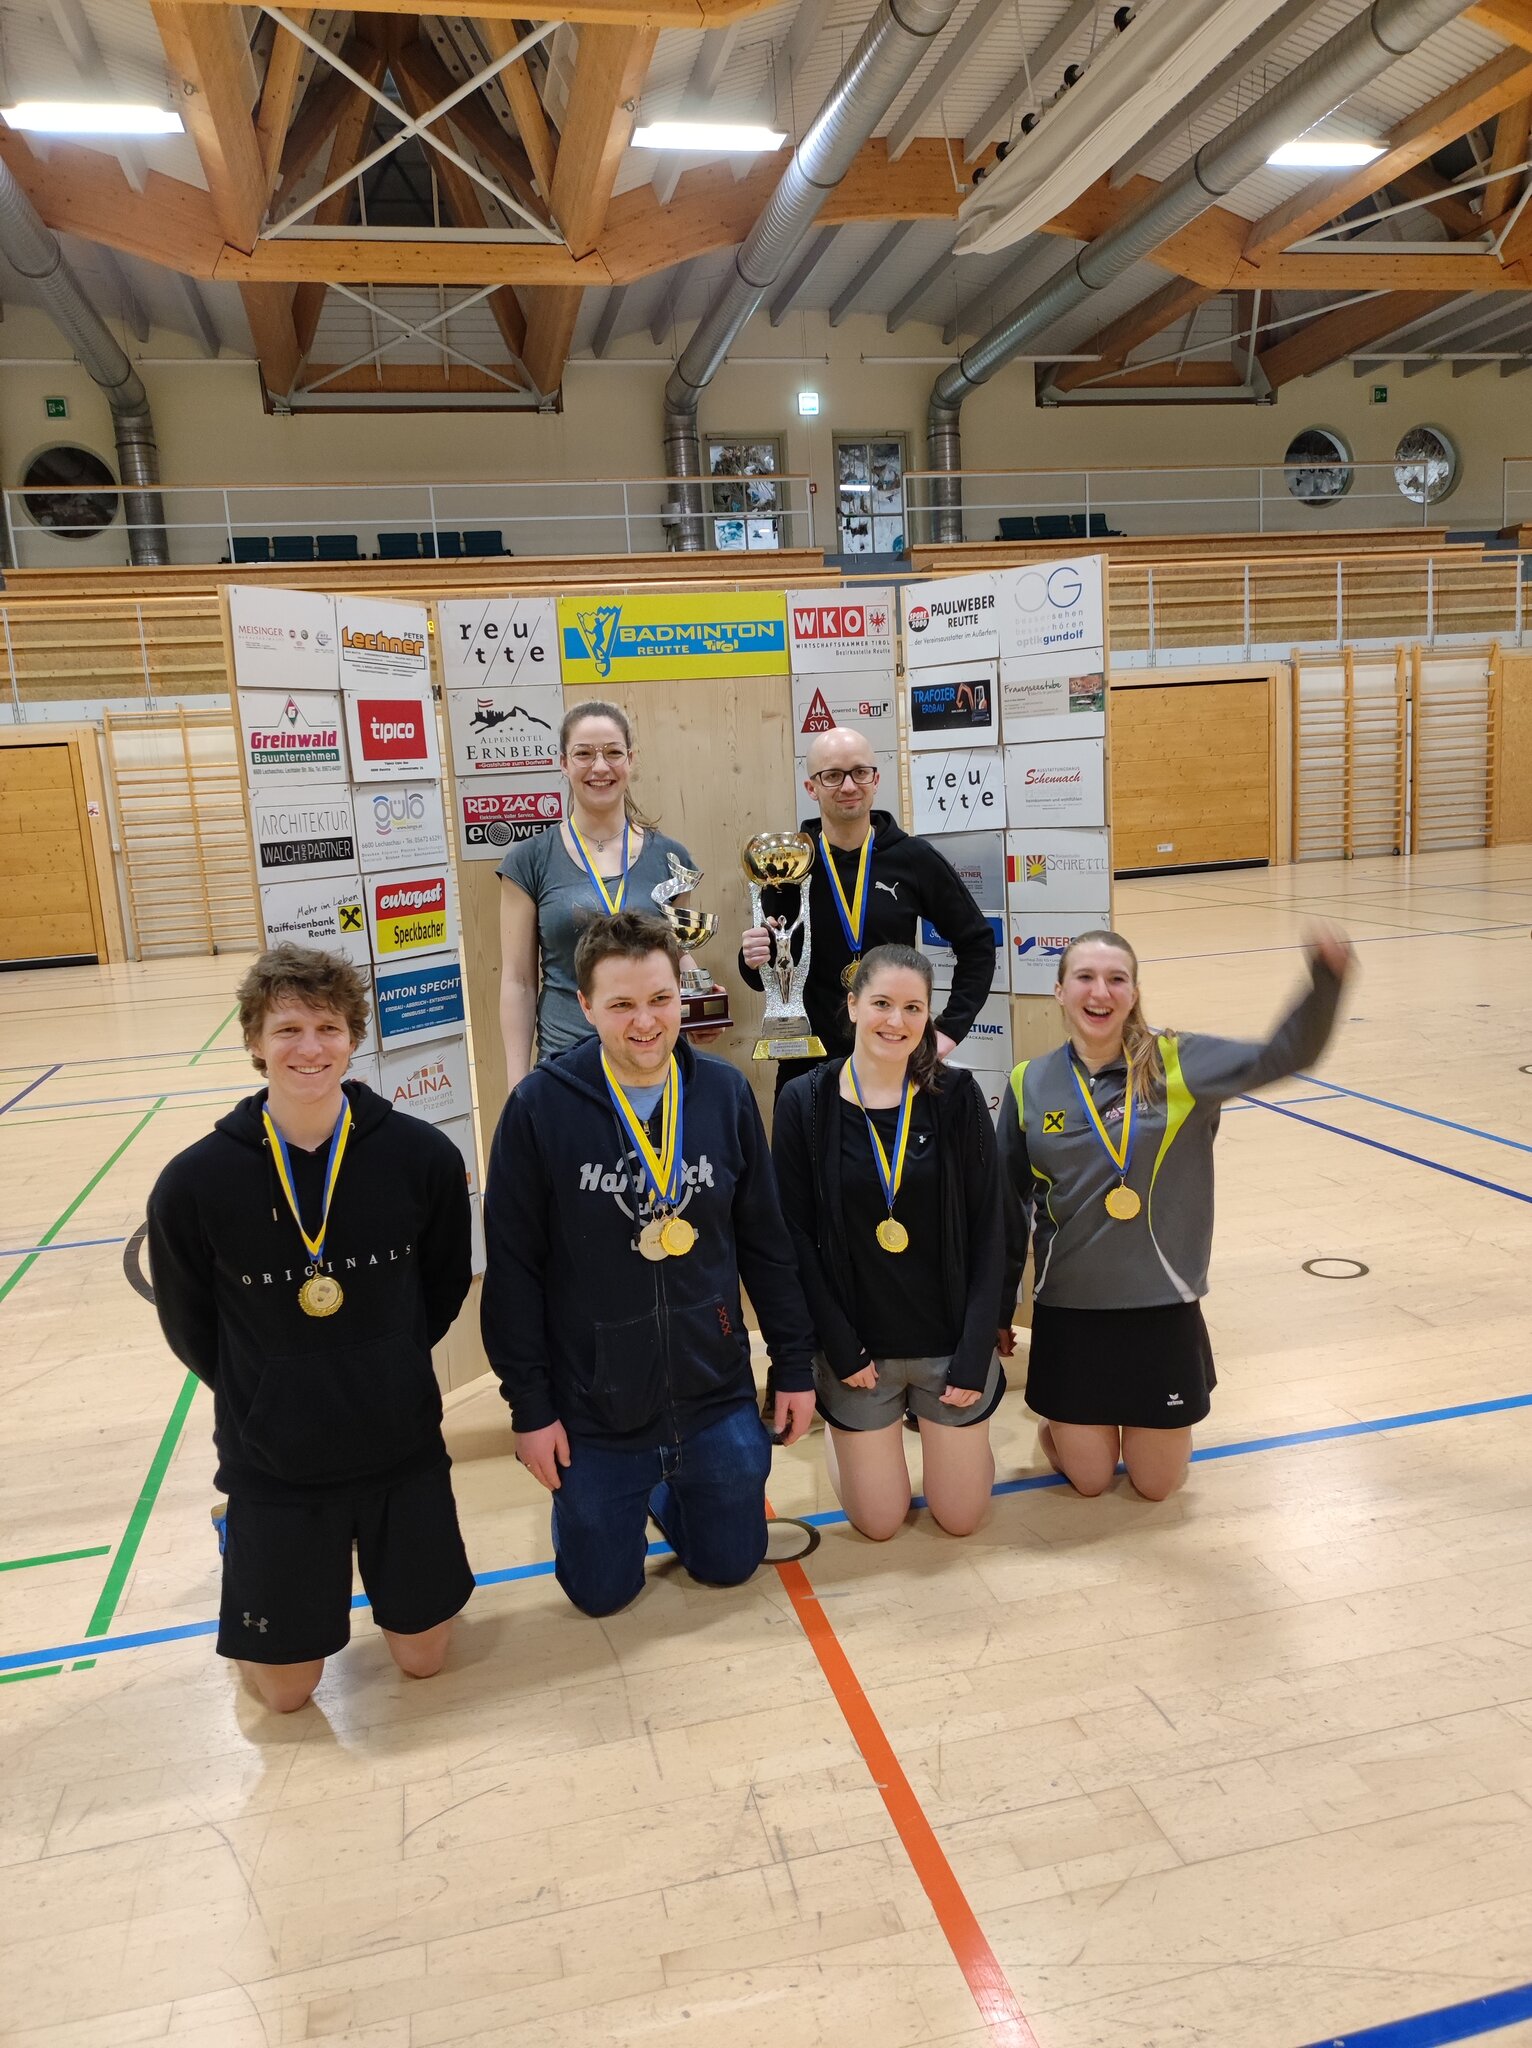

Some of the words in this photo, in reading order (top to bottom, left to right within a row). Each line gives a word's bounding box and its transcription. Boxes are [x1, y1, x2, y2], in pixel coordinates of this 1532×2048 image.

[930, 595, 995, 617] PAULWEBER
[794, 609, 862, 635] WKO
[909, 610, 927, 620] SPORT
[947, 614, 979, 628] REUTTE
[238, 625, 284, 637] MEISINGER
[620, 623, 775, 642] BADMINTON
[911, 620, 928, 629] 2000
[341, 625, 425, 656] Lechner
[403, 632, 424, 640] PETER
[637, 644, 690, 656] REUTTE
[702, 639, 739, 653] Tirol
[796, 641, 869, 649] WIRTSCHAFTSKAMMER
[913, 687, 956, 703] TRAFOIER
[921, 703, 945, 714] ERDBAU
[370, 716, 415, 744] tipico
[809, 720, 830, 731] SVR
[250, 730, 338, 750] Greinwald
[480, 735, 544, 745] ALPENHOTEL
[253, 751, 337, 764] Bauunternehmen
[465, 744, 558, 760] ERNBERG
[1024, 768, 1081, 785] Schennach
[465, 797, 500, 814] RED
[501, 795, 536, 812] ZAC
[261, 810, 349, 837] ARCHITEKTUR
[468, 826, 484, 842] e
[262, 844, 301, 864] WALCH
[307, 840, 351, 860] PARTNER
[380, 882, 443, 910] eurogast
[296, 905, 318, 919] Mehr
[332, 894, 359, 907] Leben
[267, 917, 335, 934] Raiffeisenbank
[308, 928, 337, 938] Reutte
[394, 920, 444, 948] Speckbacher
[379, 985, 418, 1003] ANTON
[419, 977, 461, 994] SPECHT
[393, 1074, 452, 1103] ALINA
[409, 1090, 454, 1108] Restaurant
[423, 1098, 454, 1112] Pizzeria
[241, 1244, 412, 1286] ORIGINALS
